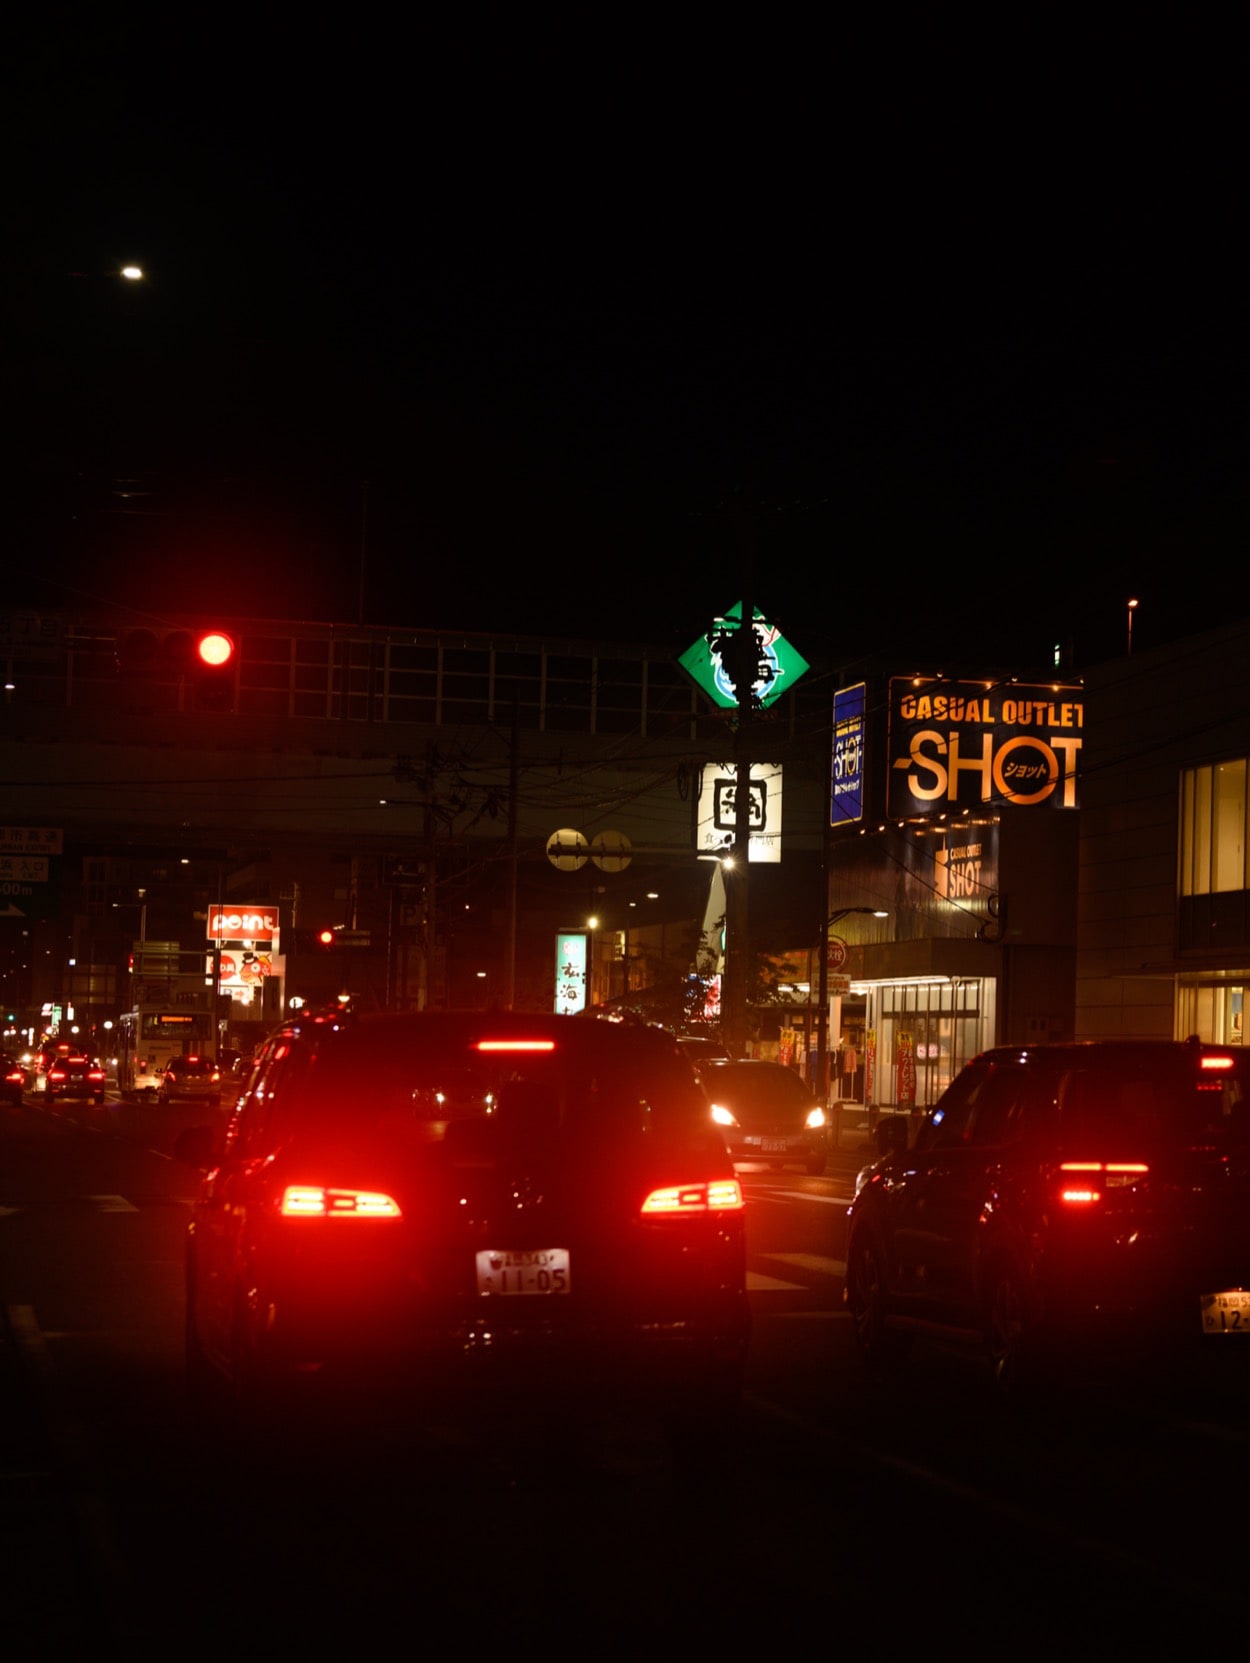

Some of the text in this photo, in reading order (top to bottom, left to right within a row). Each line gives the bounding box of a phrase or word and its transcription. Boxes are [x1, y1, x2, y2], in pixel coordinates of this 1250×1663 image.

[900, 694, 996, 723] CASUAL
[1003, 760, 1048, 780] ショット
[949, 861, 982, 898] SHOT
[502, 1268, 566, 1293] 11-05
